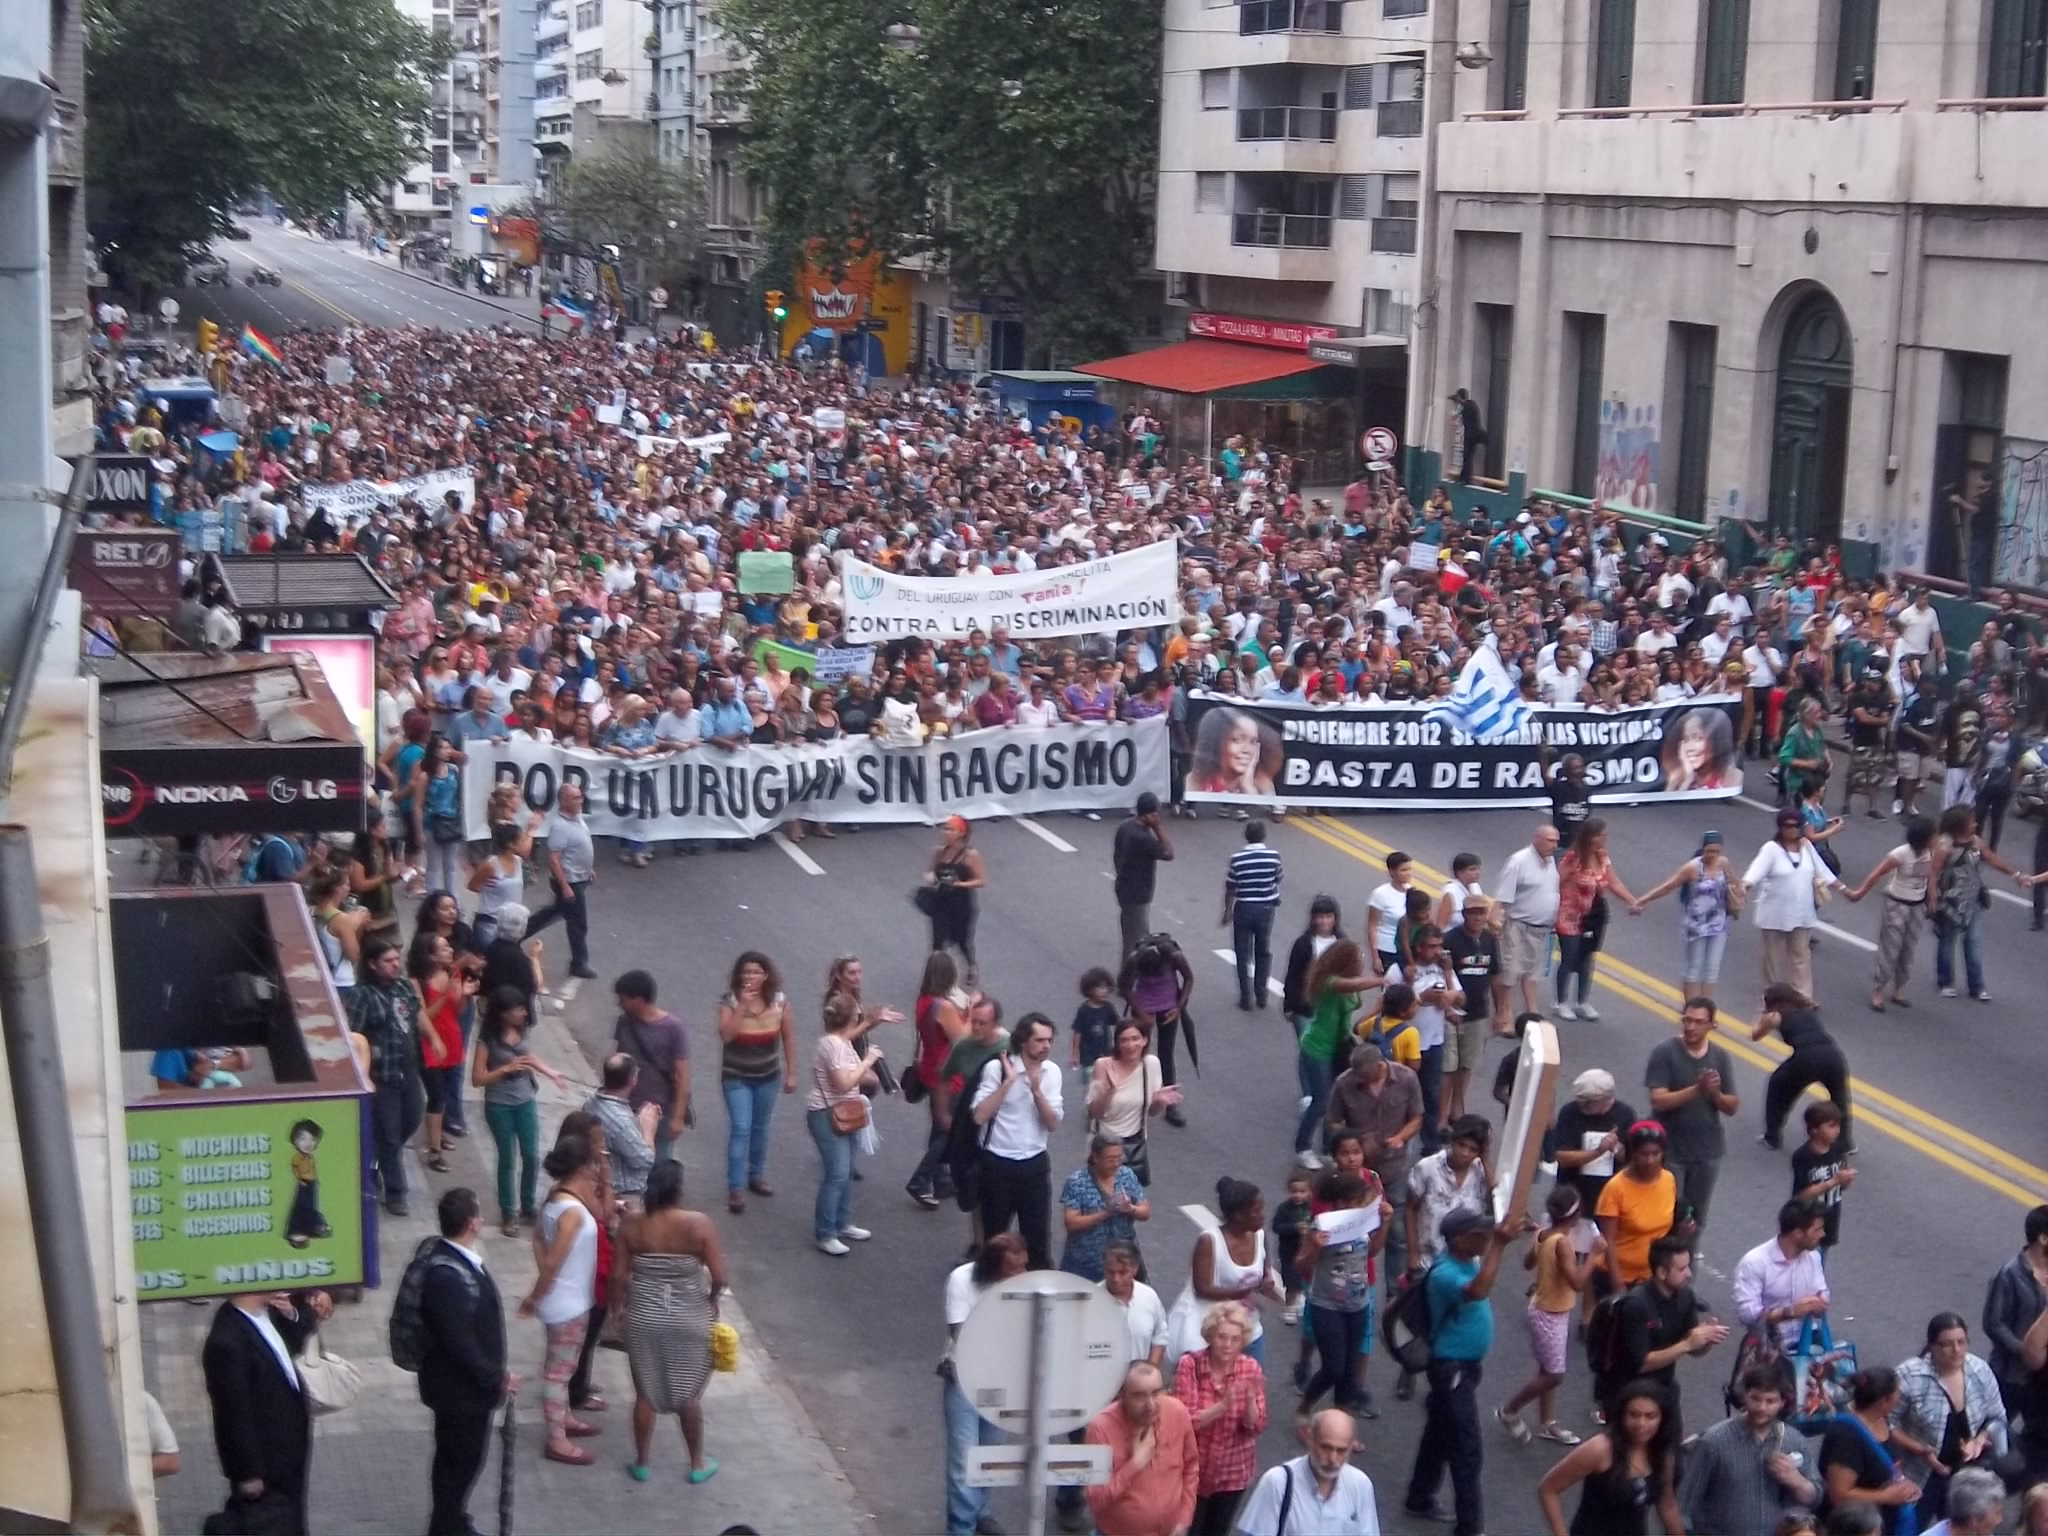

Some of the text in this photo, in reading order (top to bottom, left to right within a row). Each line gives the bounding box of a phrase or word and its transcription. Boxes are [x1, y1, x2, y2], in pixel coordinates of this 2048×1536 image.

[450, 468, 475, 480] PELO
[898, 588, 921, 602] DEL
[926, 592, 979, 604] URUGUAY
[989, 590, 1014, 601] CON
[847, 615, 941, 633] CONTRA
[952, 615, 979, 632] LA
[1282, 719, 1390, 746] DICIEMBRE
[1394, 721, 1442, 746] 2012
[1547, 721, 1578, 746] LAS
[857, 754, 928, 805] SIN
[940, 737, 1138, 802] RACISMO
[1283, 756, 1661, 789] BASTA DE RACSMO
[155, 784, 249, 804] NOKIA
[302, 779, 338, 800] LG
[182, 1135, 272, 1158] MOCHILAS
[182, 1161, 273, 1185] BILLETERAS
[183, 1187, 273, 1212] CHALINAS
[184, 1213, 273, 1237] ACCESORIOS
